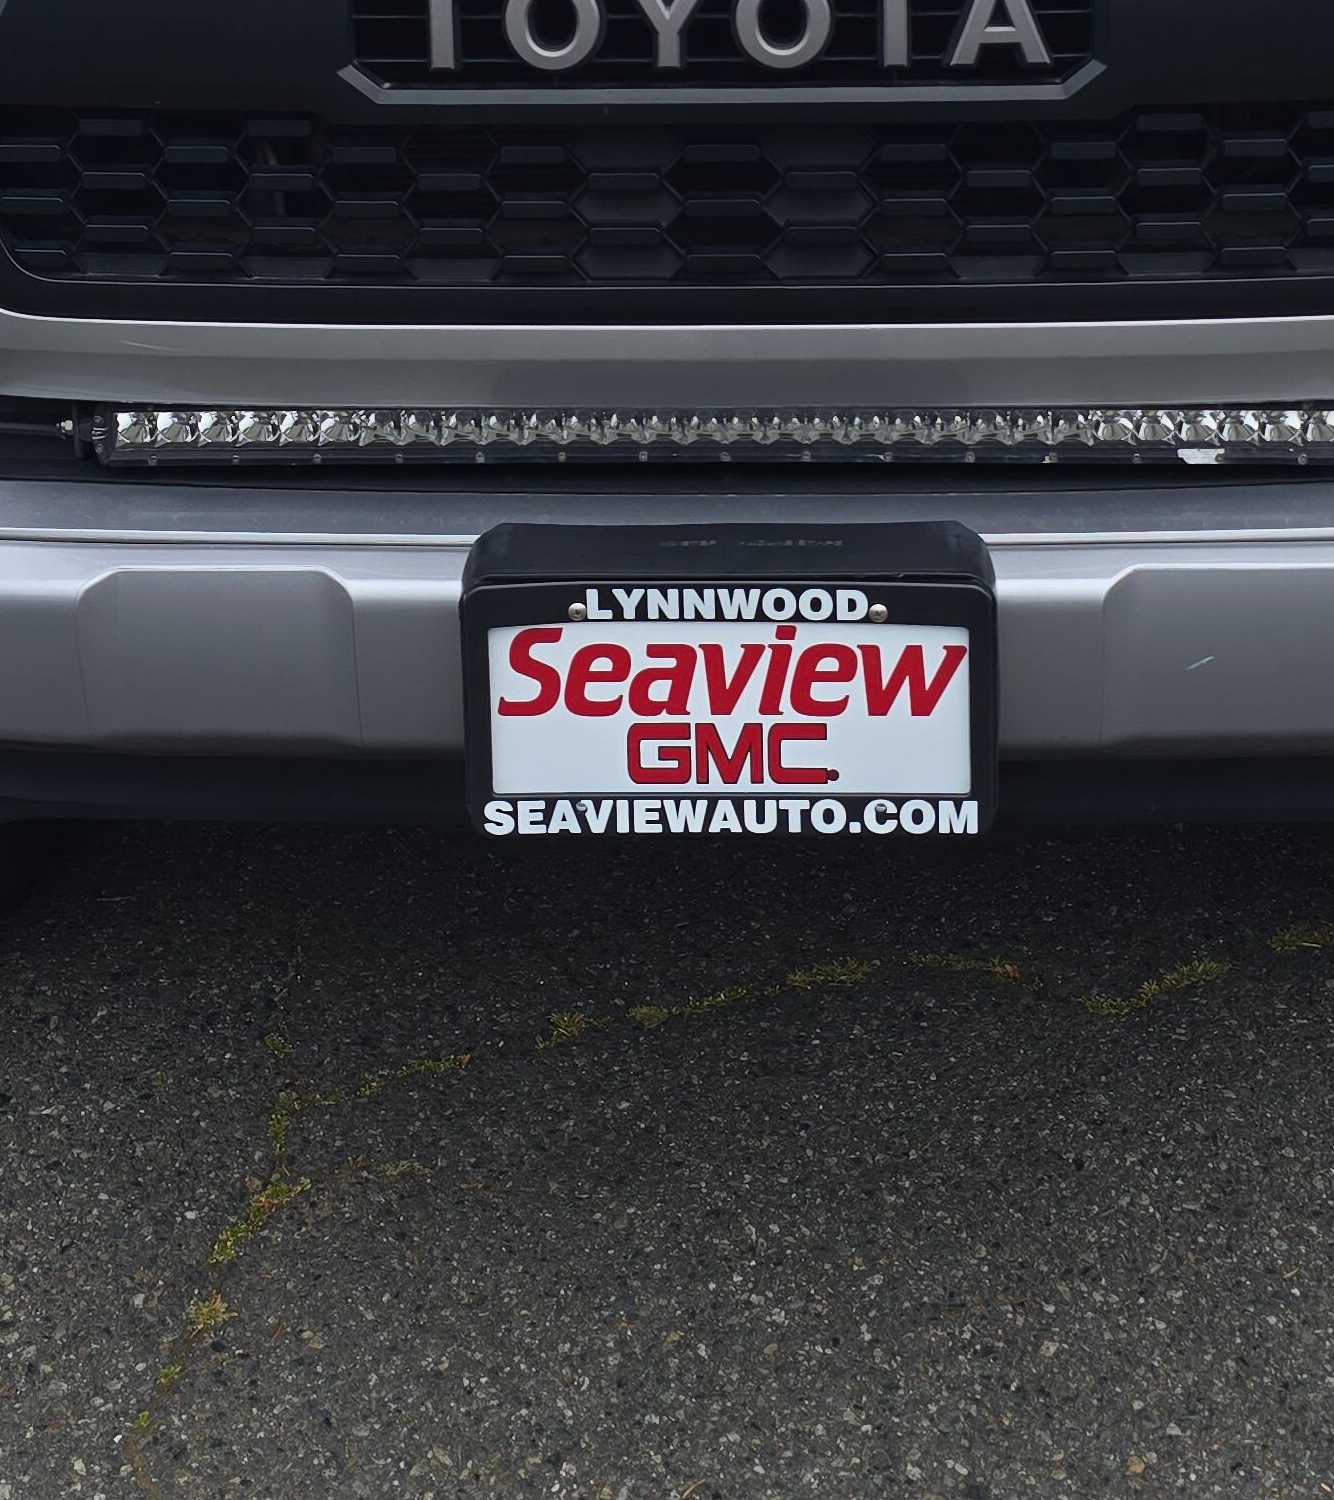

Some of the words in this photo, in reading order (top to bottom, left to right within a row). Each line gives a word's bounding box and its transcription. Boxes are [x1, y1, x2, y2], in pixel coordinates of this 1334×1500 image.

[585, 588, 868, 621] LYNNWOOD
[497, 625, 968, 718] Seaview
[626, 722, 840, 786] GMC
[483, 799, 979, 836] SEAVIEWAUTO.COM
